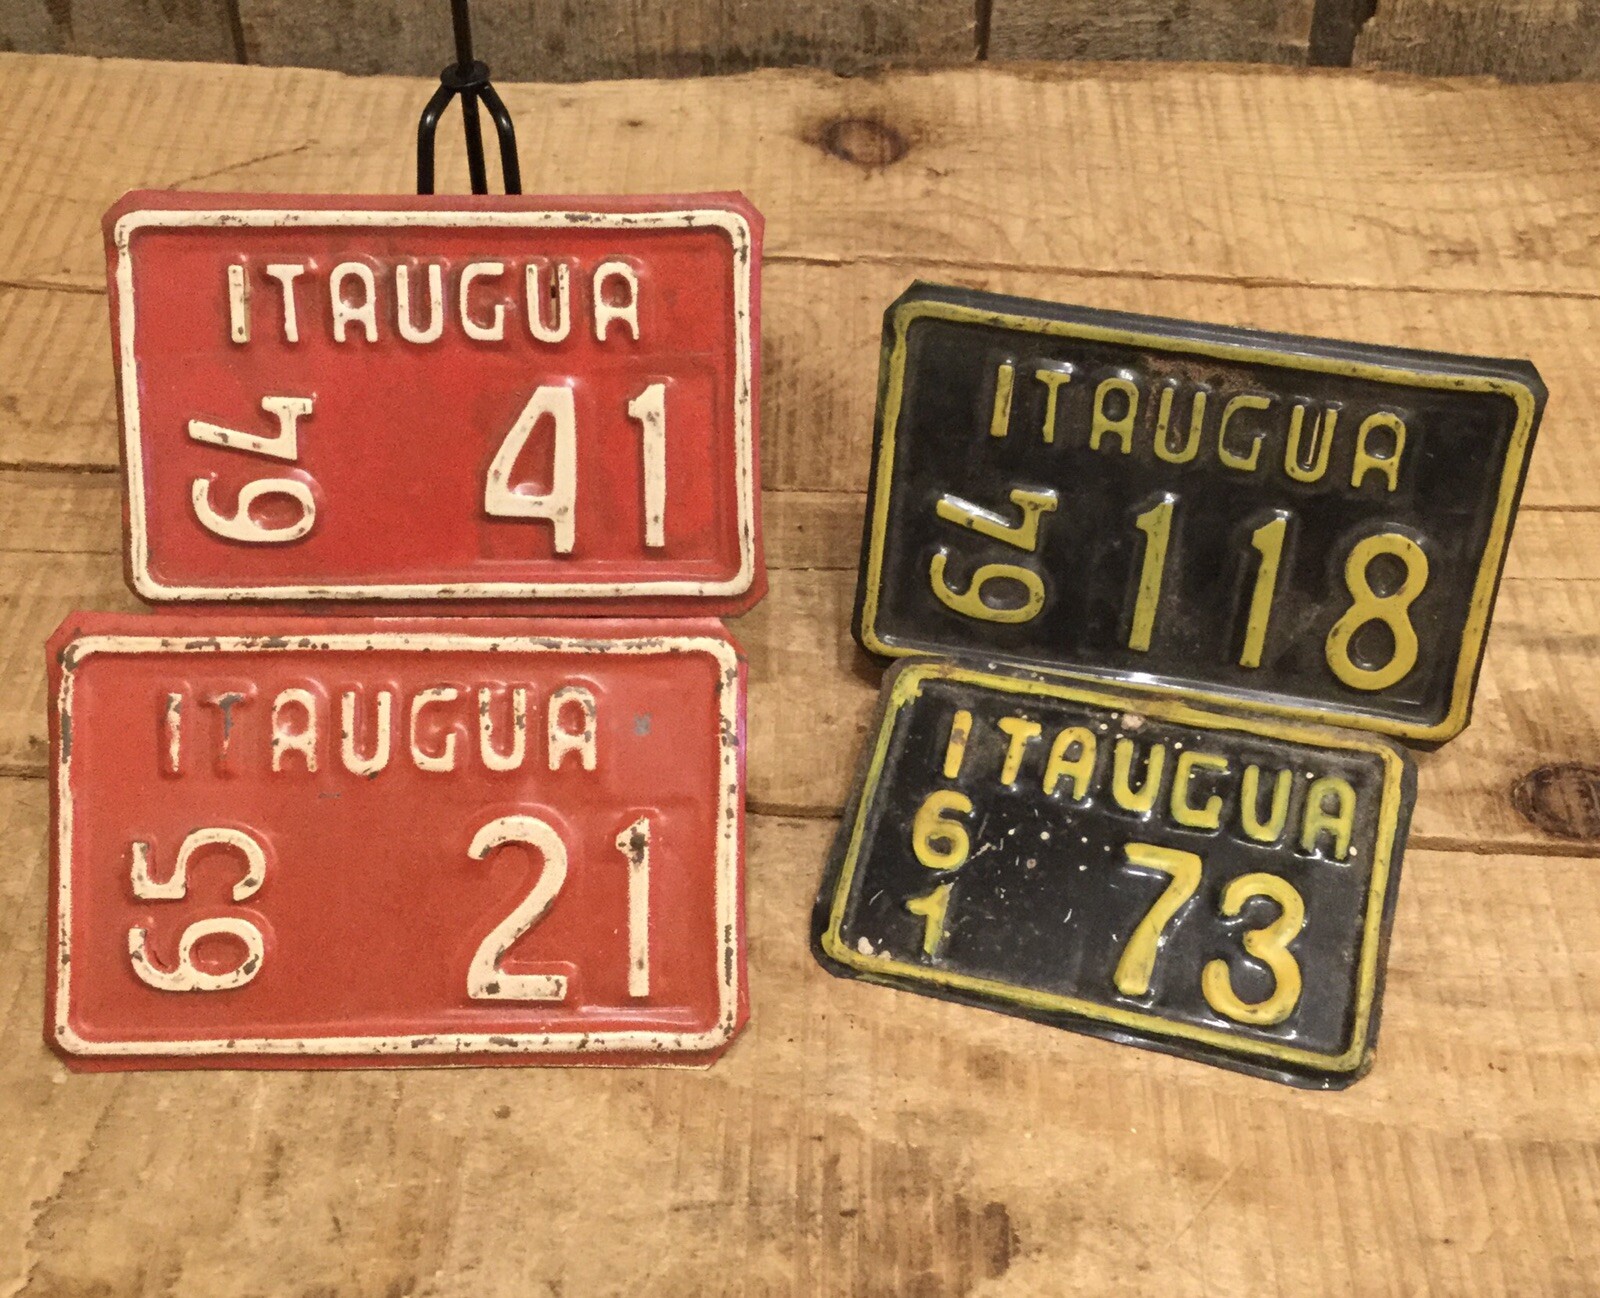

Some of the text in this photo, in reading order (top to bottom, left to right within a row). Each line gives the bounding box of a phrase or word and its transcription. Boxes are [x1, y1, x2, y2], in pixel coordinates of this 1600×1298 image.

[227, 262, 641, 344] ITAUGUA
[483, 384, 666, 555] 41
[990, 362, 1406, 492] ITAUGUA
[1135, 494, 1430, 691] 118
[165, 687, 598, 779] ITAUGUA
[942, 709, 1357, 861] ITAUGUA
[467, 814, 650, 1001] 21
[1113, 842, 1304, 1026] 73
